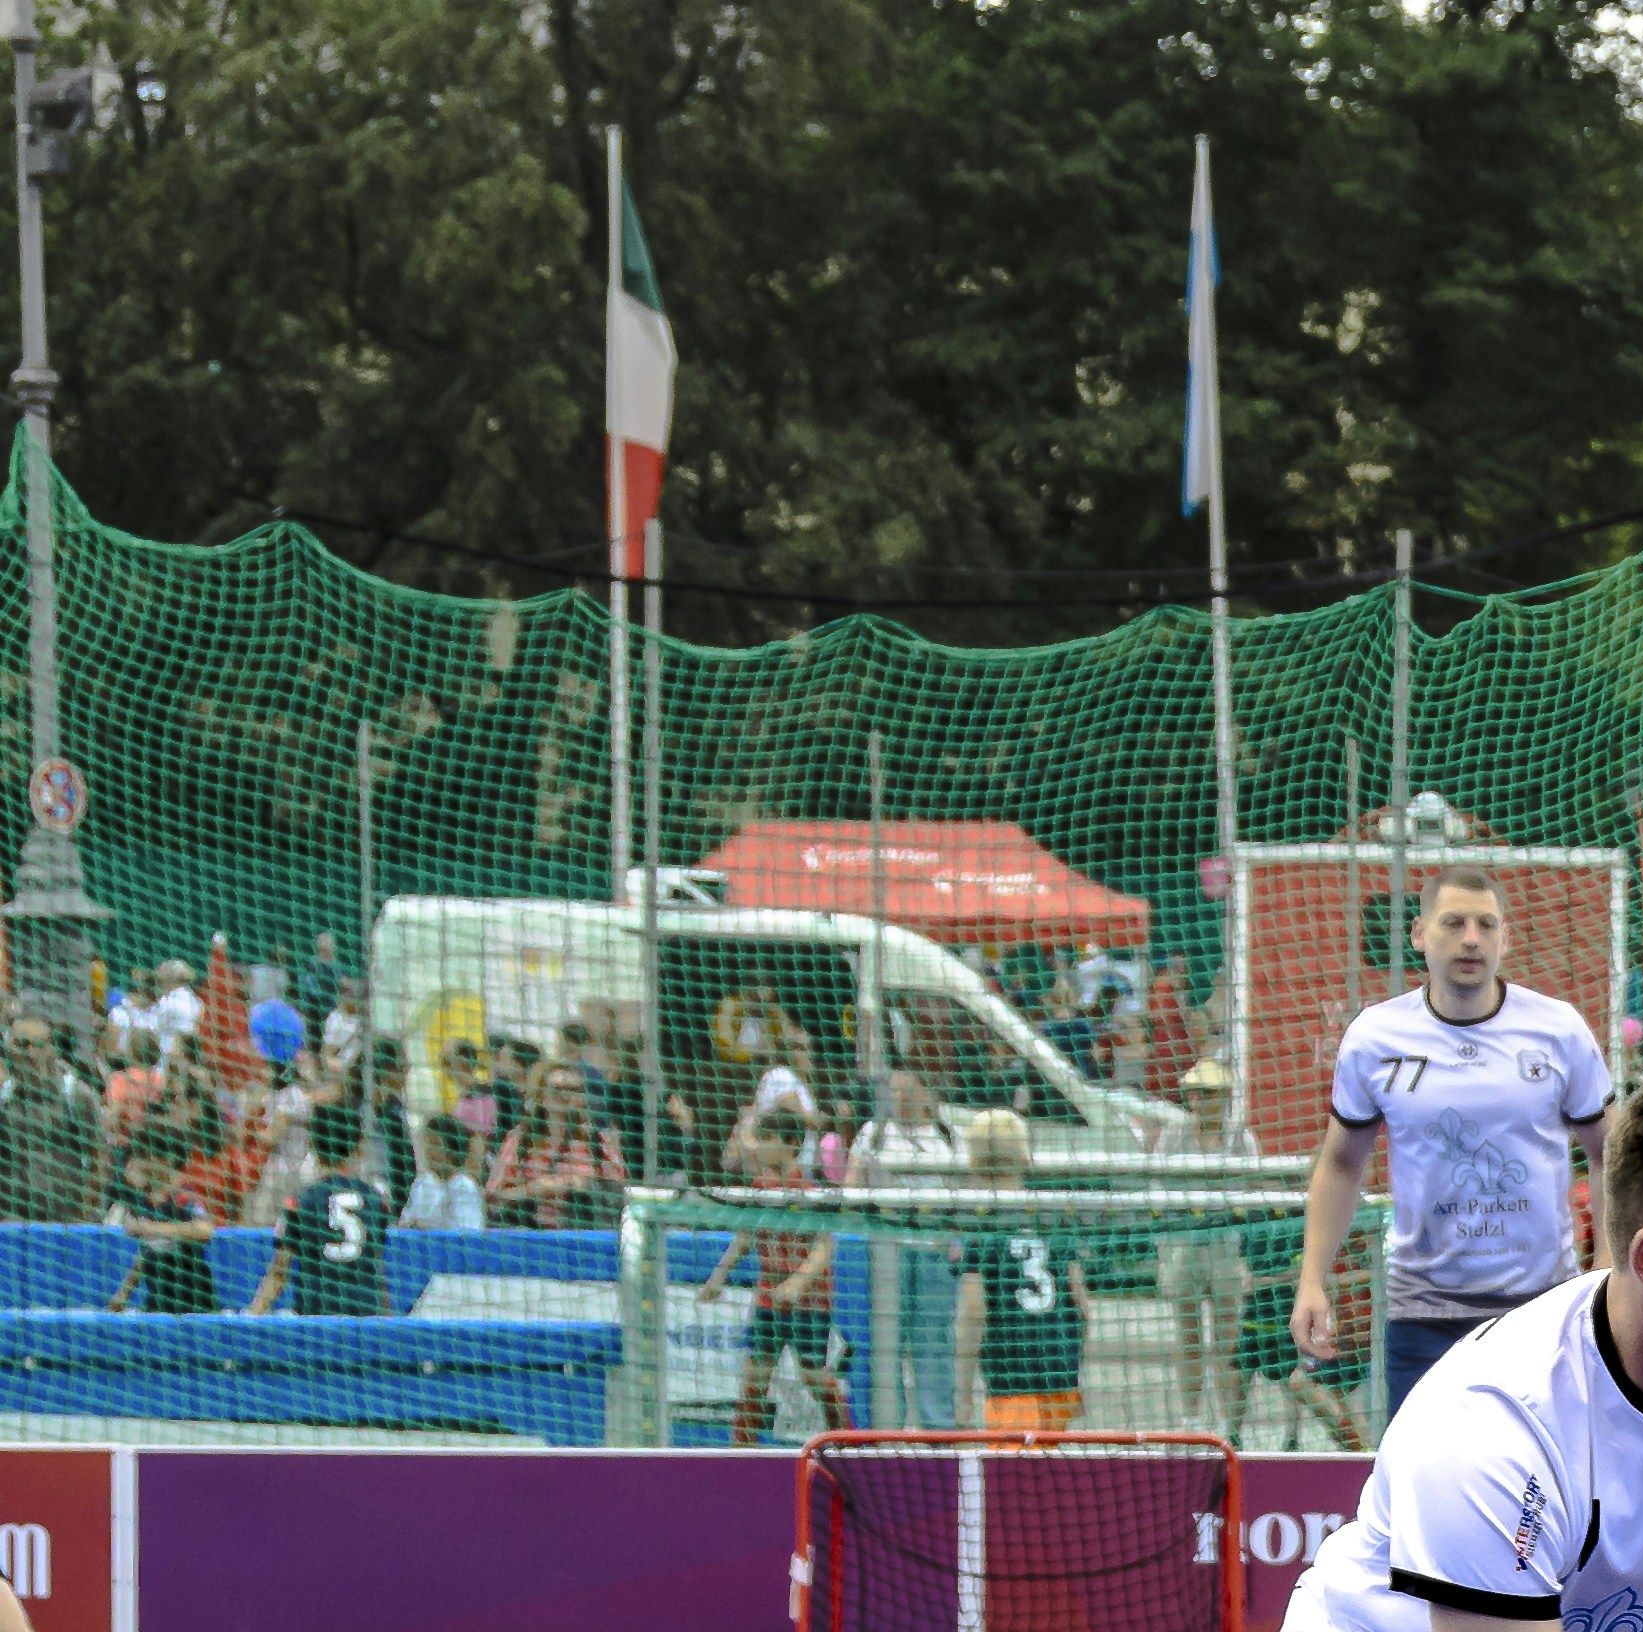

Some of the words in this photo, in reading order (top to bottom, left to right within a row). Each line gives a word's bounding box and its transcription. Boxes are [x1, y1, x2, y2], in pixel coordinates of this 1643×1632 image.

[1379, 1054, 1429, 1094] 77
[323, 1189, 367, 1262] 5
[1008, 1236, 1057, 1315] 3
